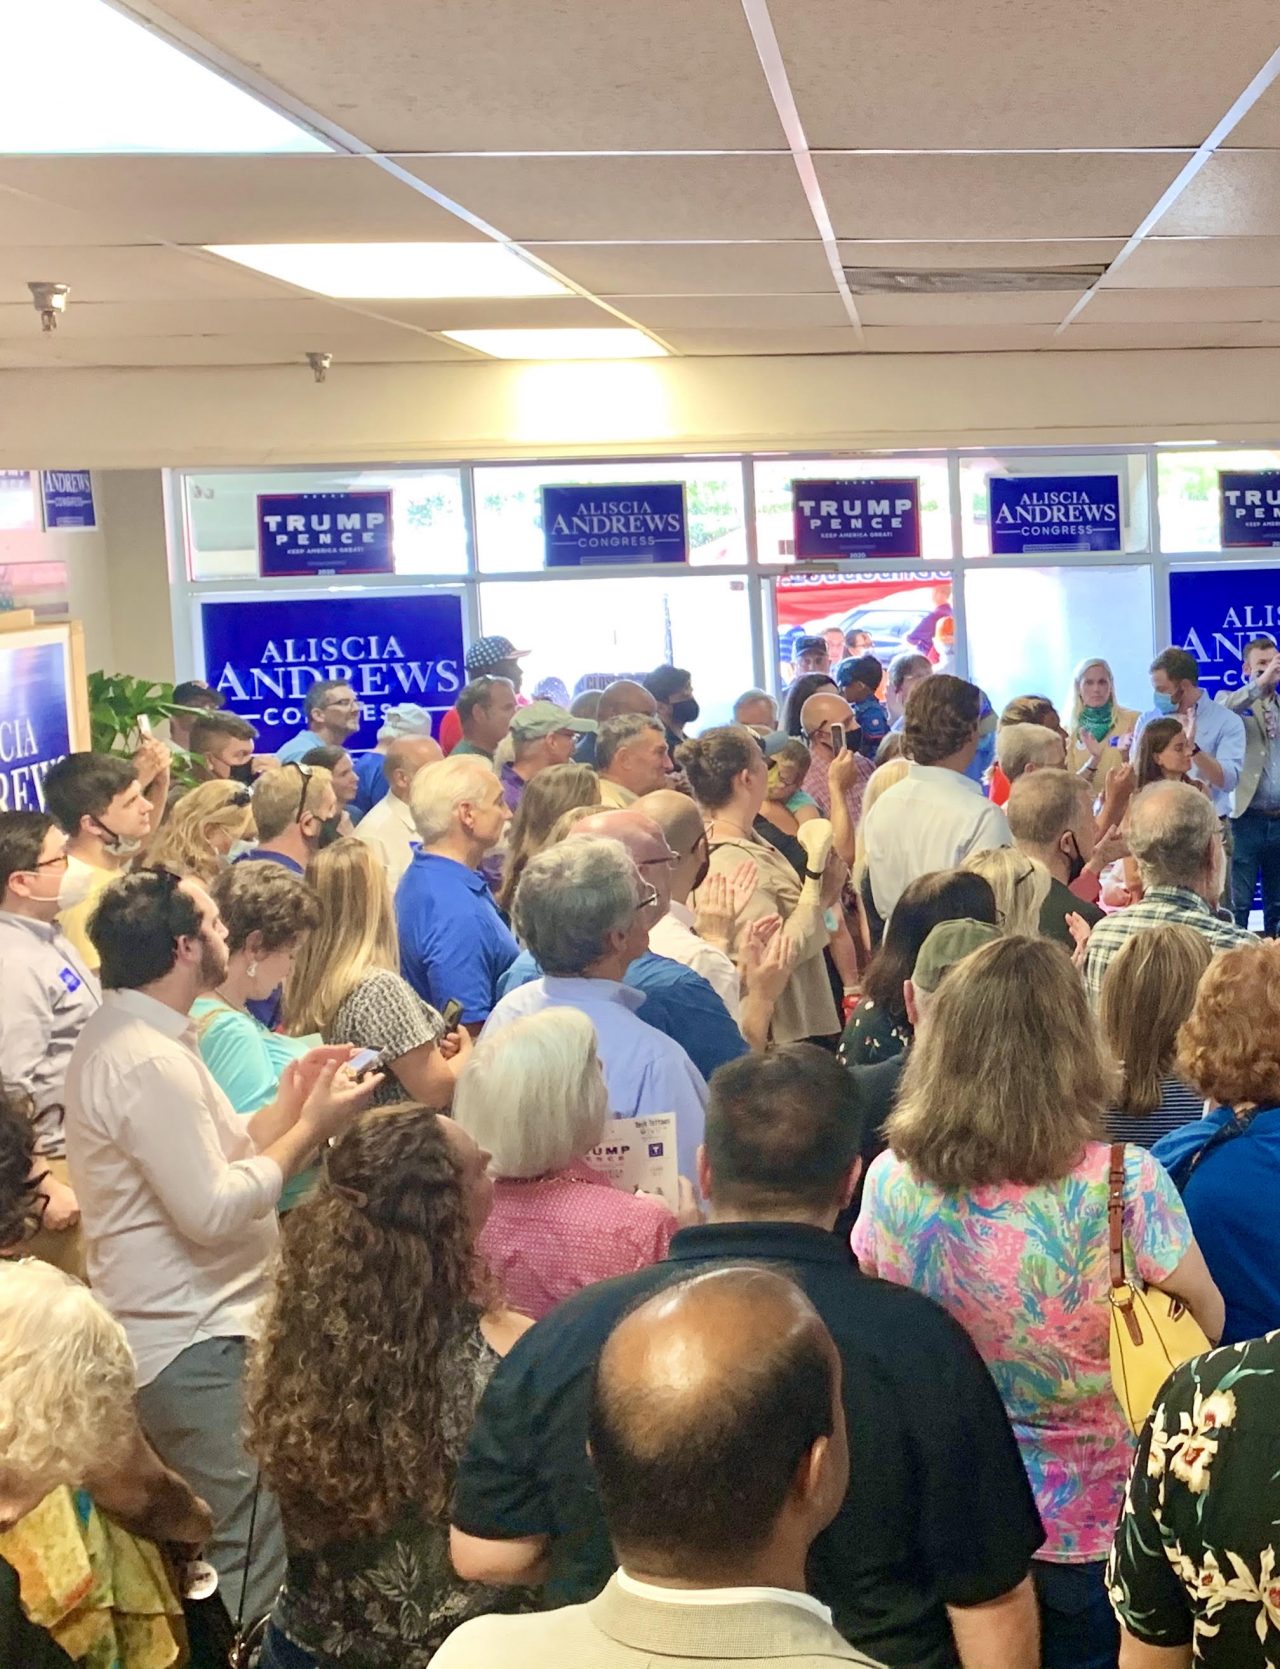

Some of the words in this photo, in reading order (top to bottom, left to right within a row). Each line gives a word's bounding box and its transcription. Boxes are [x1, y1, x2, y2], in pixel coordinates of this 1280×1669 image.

[1020, 491, 1090, 505] ALISCIA
[576, 501, 651, 515] ALISCIA
[798, 498, 912, 516] TRUMP
[995, 503, 1116, 524] ANDREWS
[263, 512, 385, 532] TRUMP
[551, 513, 680, 535] ANDREWS
[810, 517, 902, 529] PENCE
[1021, 525, 1093, 536] CONGRESS
[275, 532, 375, 546] PENCE
[578, 536, 655, 548] CONGRESS
[261, 635, 406, 664] ALISCIA
